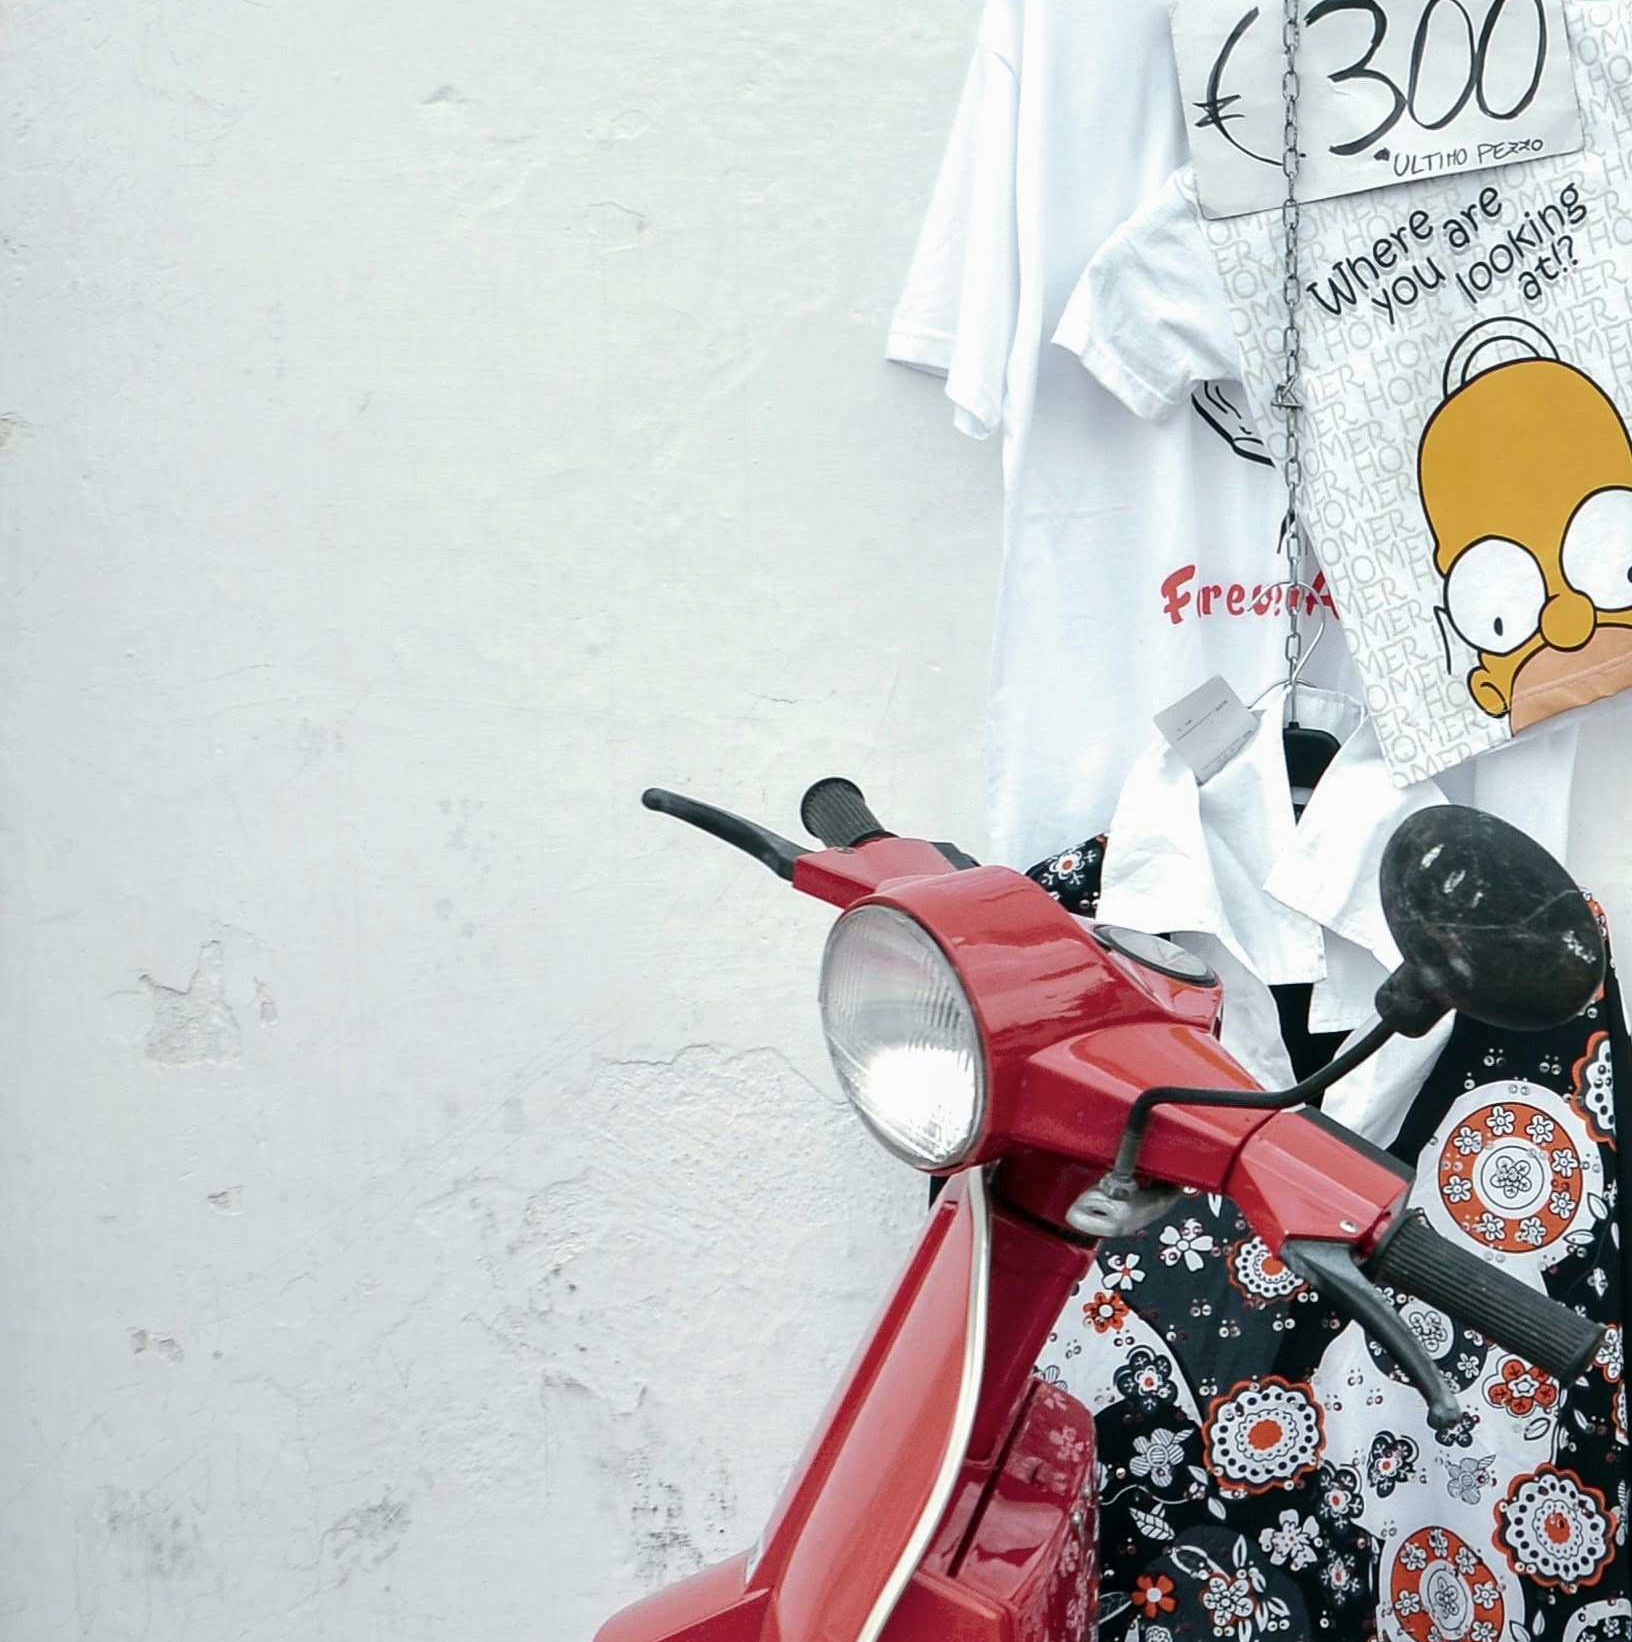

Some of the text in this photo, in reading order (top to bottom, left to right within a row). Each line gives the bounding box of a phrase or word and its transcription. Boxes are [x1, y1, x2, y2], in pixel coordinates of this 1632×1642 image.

[1306, 210, 1433, 315] Where
[1443, 187, 1502, 248] are
[1371, 257, 1446, 325] you
[1456, 182, 1587, 304] looking
[1518, 235, 1578, 300] at!?
